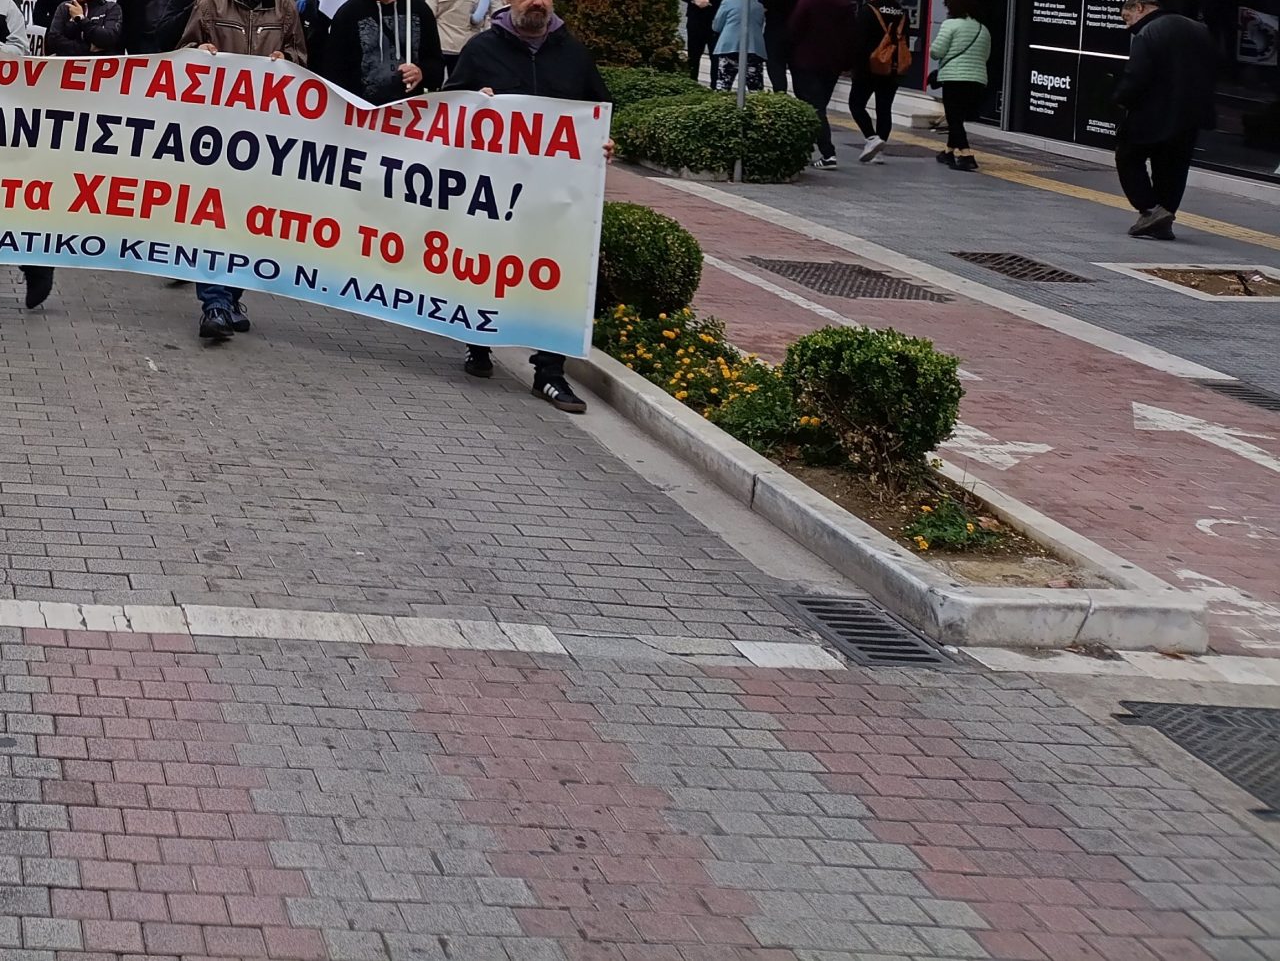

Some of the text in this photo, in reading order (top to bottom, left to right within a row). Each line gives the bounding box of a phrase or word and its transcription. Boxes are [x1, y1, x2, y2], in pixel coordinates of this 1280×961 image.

[60, 58, 329, 120] ΕΡΓΑΣΙΑΚΟ
[344, 100, 581, 160] ΜΕΣΑΙΩΝΑ
[1031, 70, 1071, 90] Respect
[1, 178, 53, 211] τα
[67, 173, 226, 229] ΧΕΡΙΑ
[246, 203, 341, 248] απο
[358, 225, 404, 264] το
[422, 230, 561, 298] 8ωρο
[380, 156, 523, 221] ΤΩΡΑ!
[119, 238, 280, 280] ΚΕΝΤΡΟ
[294, 265, 328, 292] Ν.
[340, 277, 499, 333] ΛΑΡΙΣΑΣ
